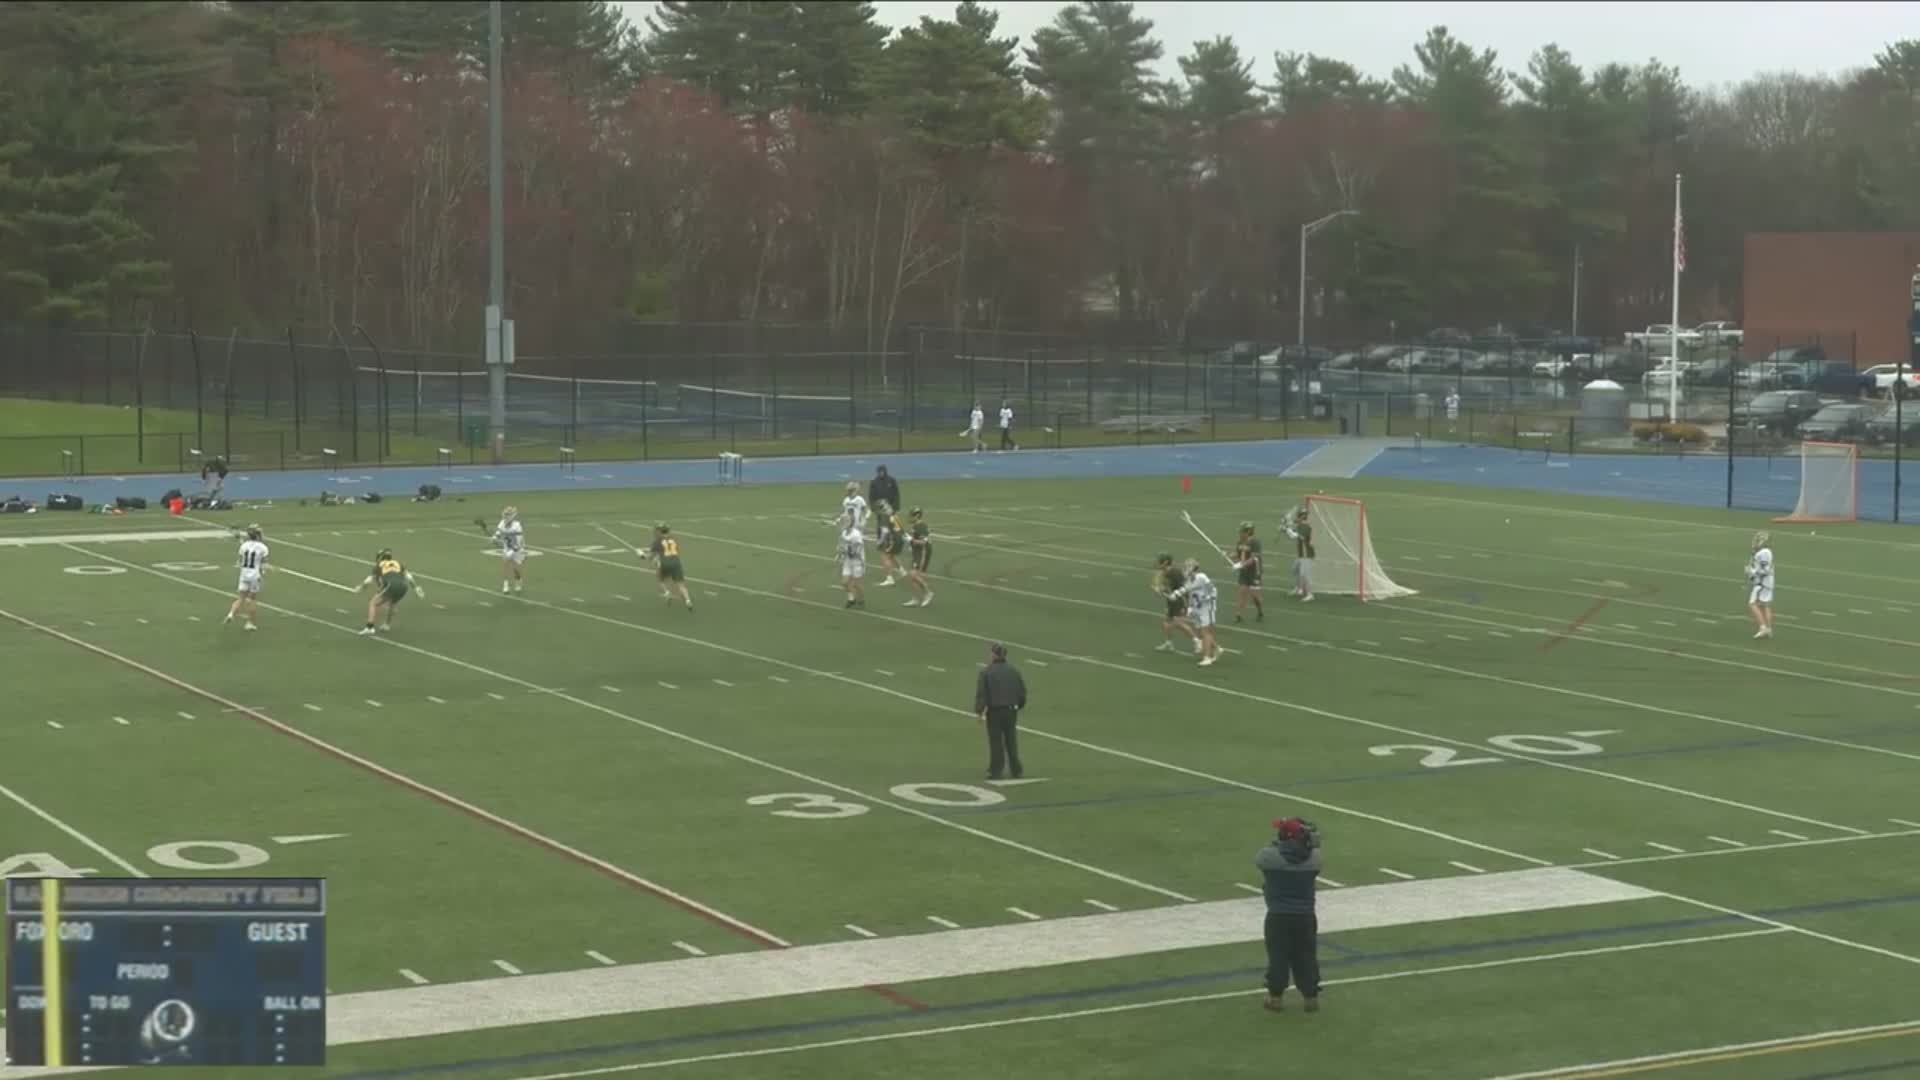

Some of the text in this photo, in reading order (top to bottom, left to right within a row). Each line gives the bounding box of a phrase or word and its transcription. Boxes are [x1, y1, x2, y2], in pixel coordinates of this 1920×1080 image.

[244, 550, 256, 569] 11
[1368, 734, 1604, 768] 20
[746, 782, 1006, 818] 30
